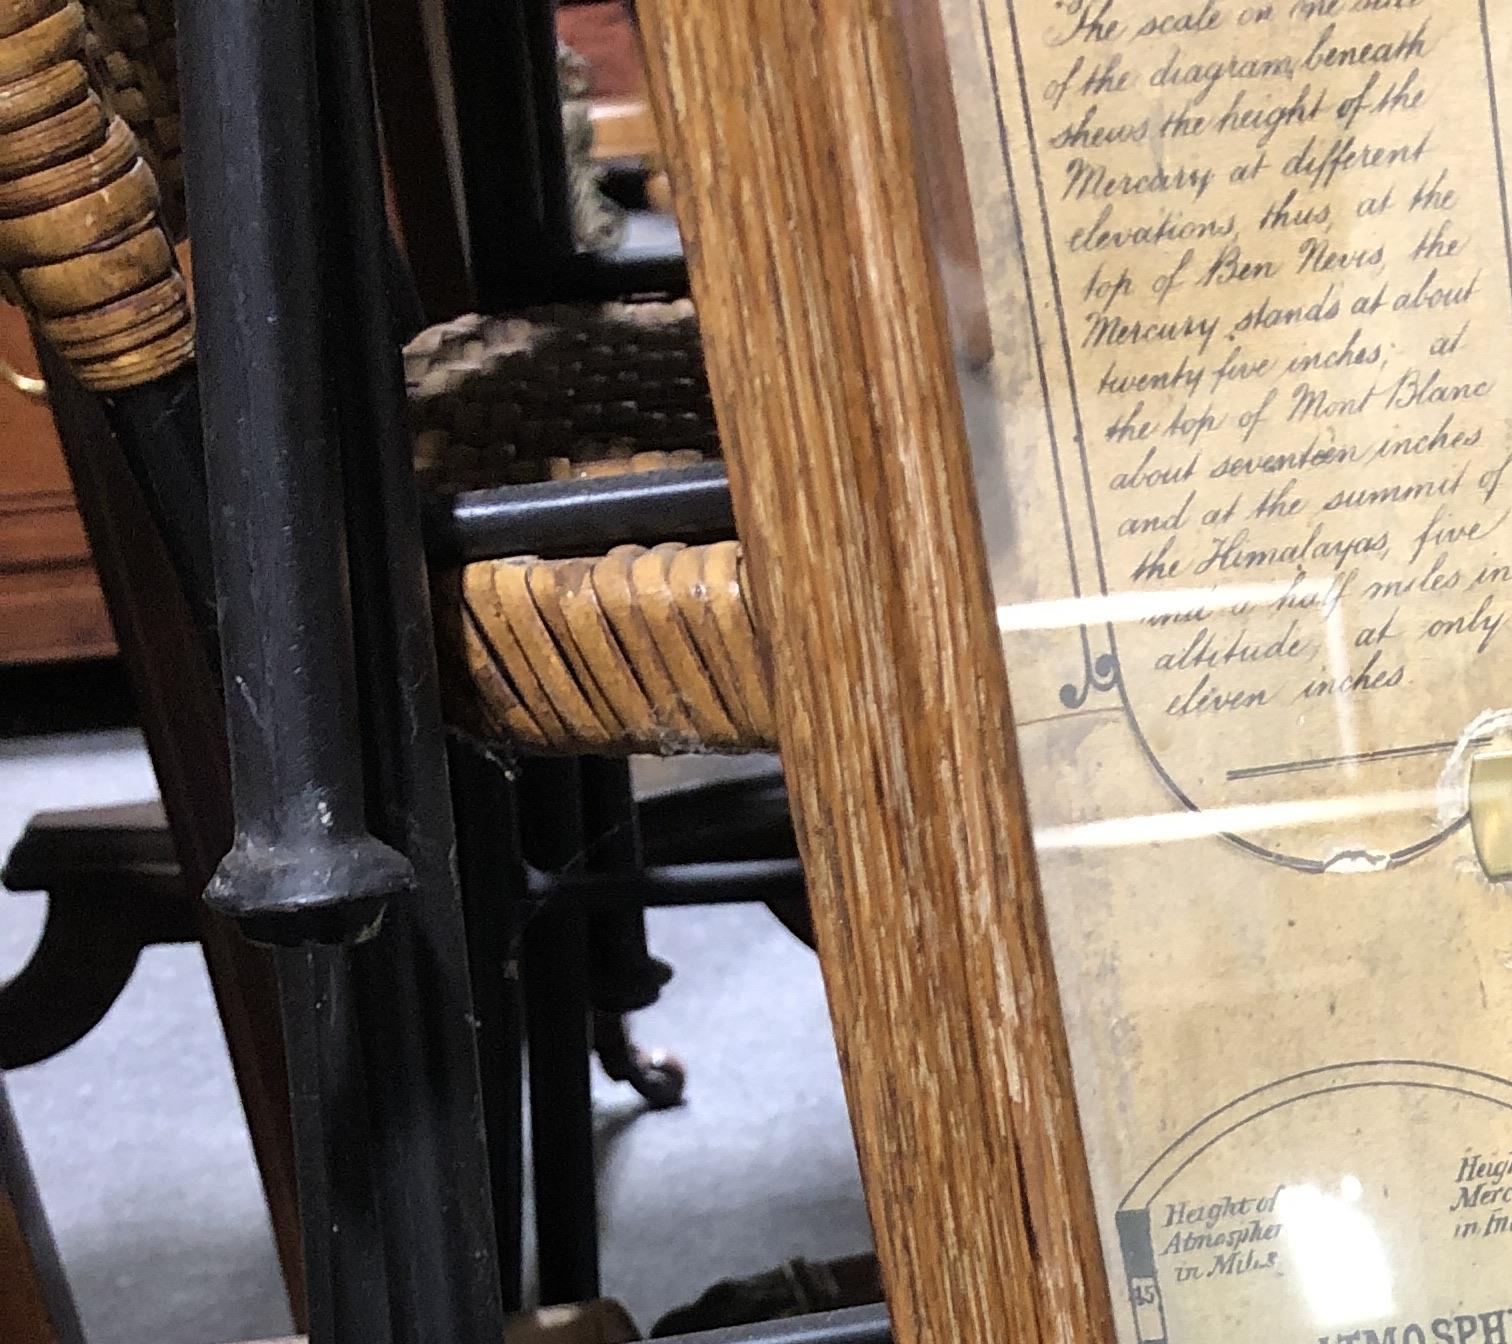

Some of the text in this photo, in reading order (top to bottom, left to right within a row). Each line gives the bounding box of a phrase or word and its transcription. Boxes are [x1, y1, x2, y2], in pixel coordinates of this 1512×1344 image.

[1043, 55, 1085, 110] of
[1081, 52, 1131, 96] the
[1301, 17, 1430, 70] beneath
[1049, 67, 1425, 150] shews the height of the
[1062, 125, 1434, 201] Mercury at different
[1259, 188, 1335, 233] thus,
[1357, 188, 1393, 219] at
[1408, 170, 1458, 214] the
[1082, 266, 1134, 307] top
[1152, 249, 1195, 301] of
[1197, 244, 1278, 289] Ben
[1410, 220, 1467, 261] the
[1082, 268, 1481, 356] Mercury stands at about
[1098, 355, 1205, 397] twenty
[1211, 352, 1277, 393] five
[1429, 323, 1469, 356] at
[1104, 371, 1495, 444] the top of Mont Blanc
[1108, 414, 1483, 491] about seventeen inches
[1117, 499, 1188, 538] and
[1202, 495, 1235, 526] at
[1251, 486, 1305, 525] the
[1321, 470, 1462, 510] summit
[1129, 537, 1185, 583] the
[1413, 508, 1511, 559] five
[1276, 567, 1359, 622] half
[1363, 570, 1471, 602] miles
[1354, 620, 1398, 649] at
[1424, 608, 1509, 653] only
[1166, 673, 1281, 716] eleven
[1161, 1196, 1252, 1229] Height
[1454, 1221, 1479, 1238] in
[1174, 1264, 1203, 1282] in
